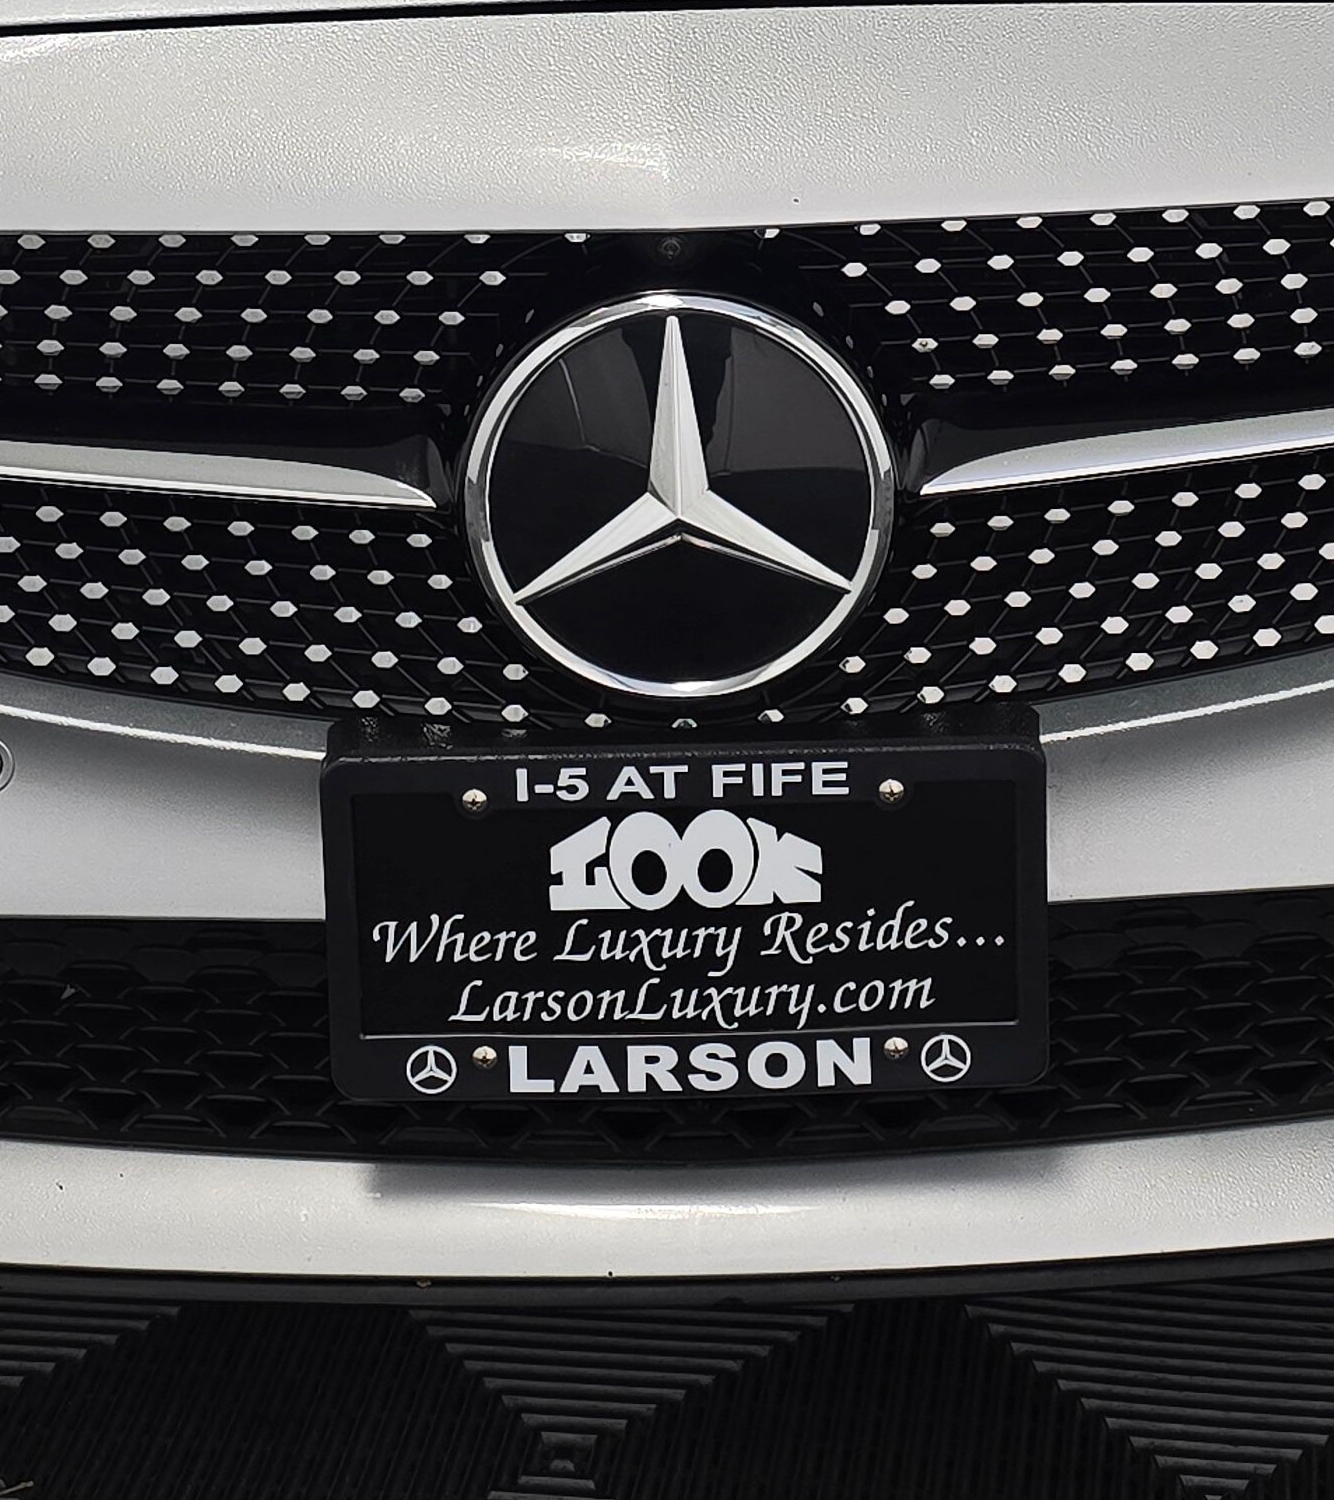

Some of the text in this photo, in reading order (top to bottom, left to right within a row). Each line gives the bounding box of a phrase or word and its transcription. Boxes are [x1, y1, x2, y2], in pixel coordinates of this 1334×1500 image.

[515, 761, 850, 802] I-5 AT FIFE
[372, 900, 1005, 977] Where Luxury Resides...
[447, 977, 936, 1030] LarsonLuxury.com
[508, 1037, 872, 1093] LARSON
